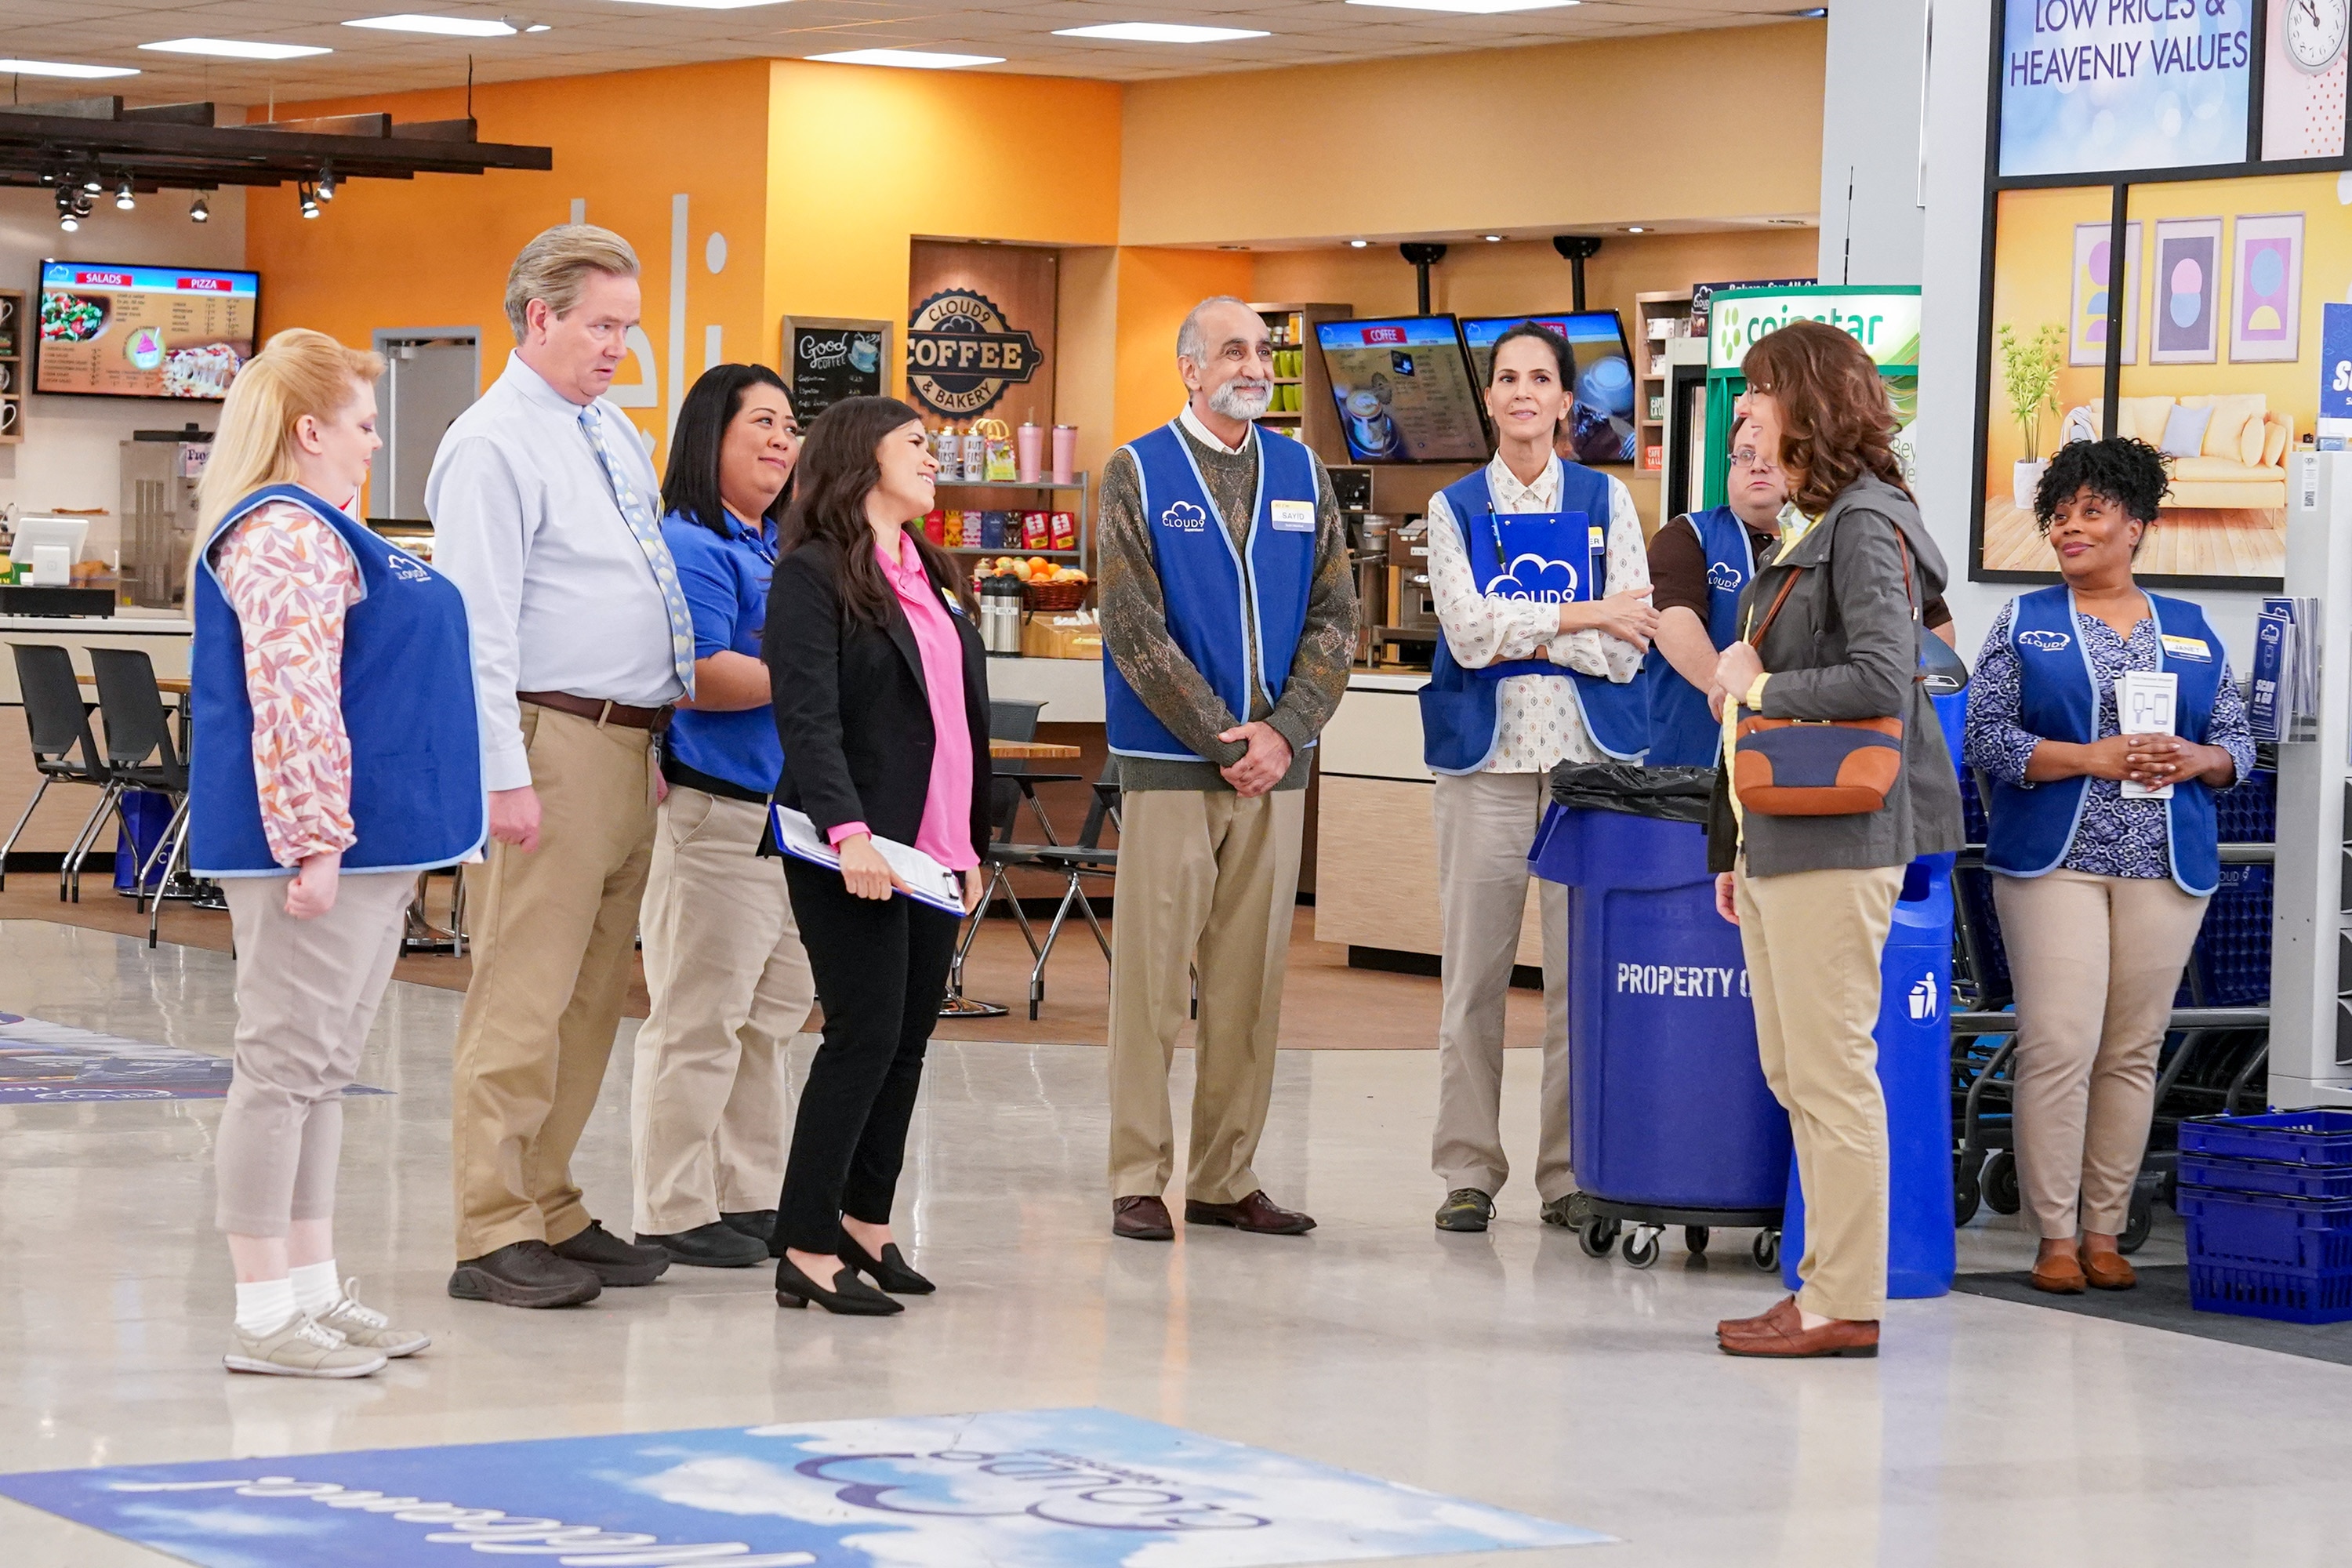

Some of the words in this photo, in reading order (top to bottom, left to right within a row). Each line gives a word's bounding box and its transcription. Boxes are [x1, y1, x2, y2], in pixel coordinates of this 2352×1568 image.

[2035, 0, 2098, 32] LOW
[2109, 0, 2195, 26] PRICES
[2010, 41, 2142, 86] HEAVENLY
[2151, 31, 2248, 76] VALUES
[86, 274, 121, 285] SALADS
[191, 278, 217, 289] PIZZA
[929, 300, 991, 323] CLOUD9
[1370, 328, 1398, 342] COFFEE
[1747, 304, 1883, 347] coitar
[800, 332, 849, 368] Good
[907, 338, 1022, 369] COFFEE
[922, 380, 933, 394] &
[935, 382, 992, 408] BAKERY
[1162, 517, 1205, 528] CLOUD9
[1282, 512, 1305, 521] SAYID
[1708, 576, 1739, 589] LOUD9
[2018, 636, 2068, 649] CLOUD9
[1617, 962, 1738, 997] PROPERTY
